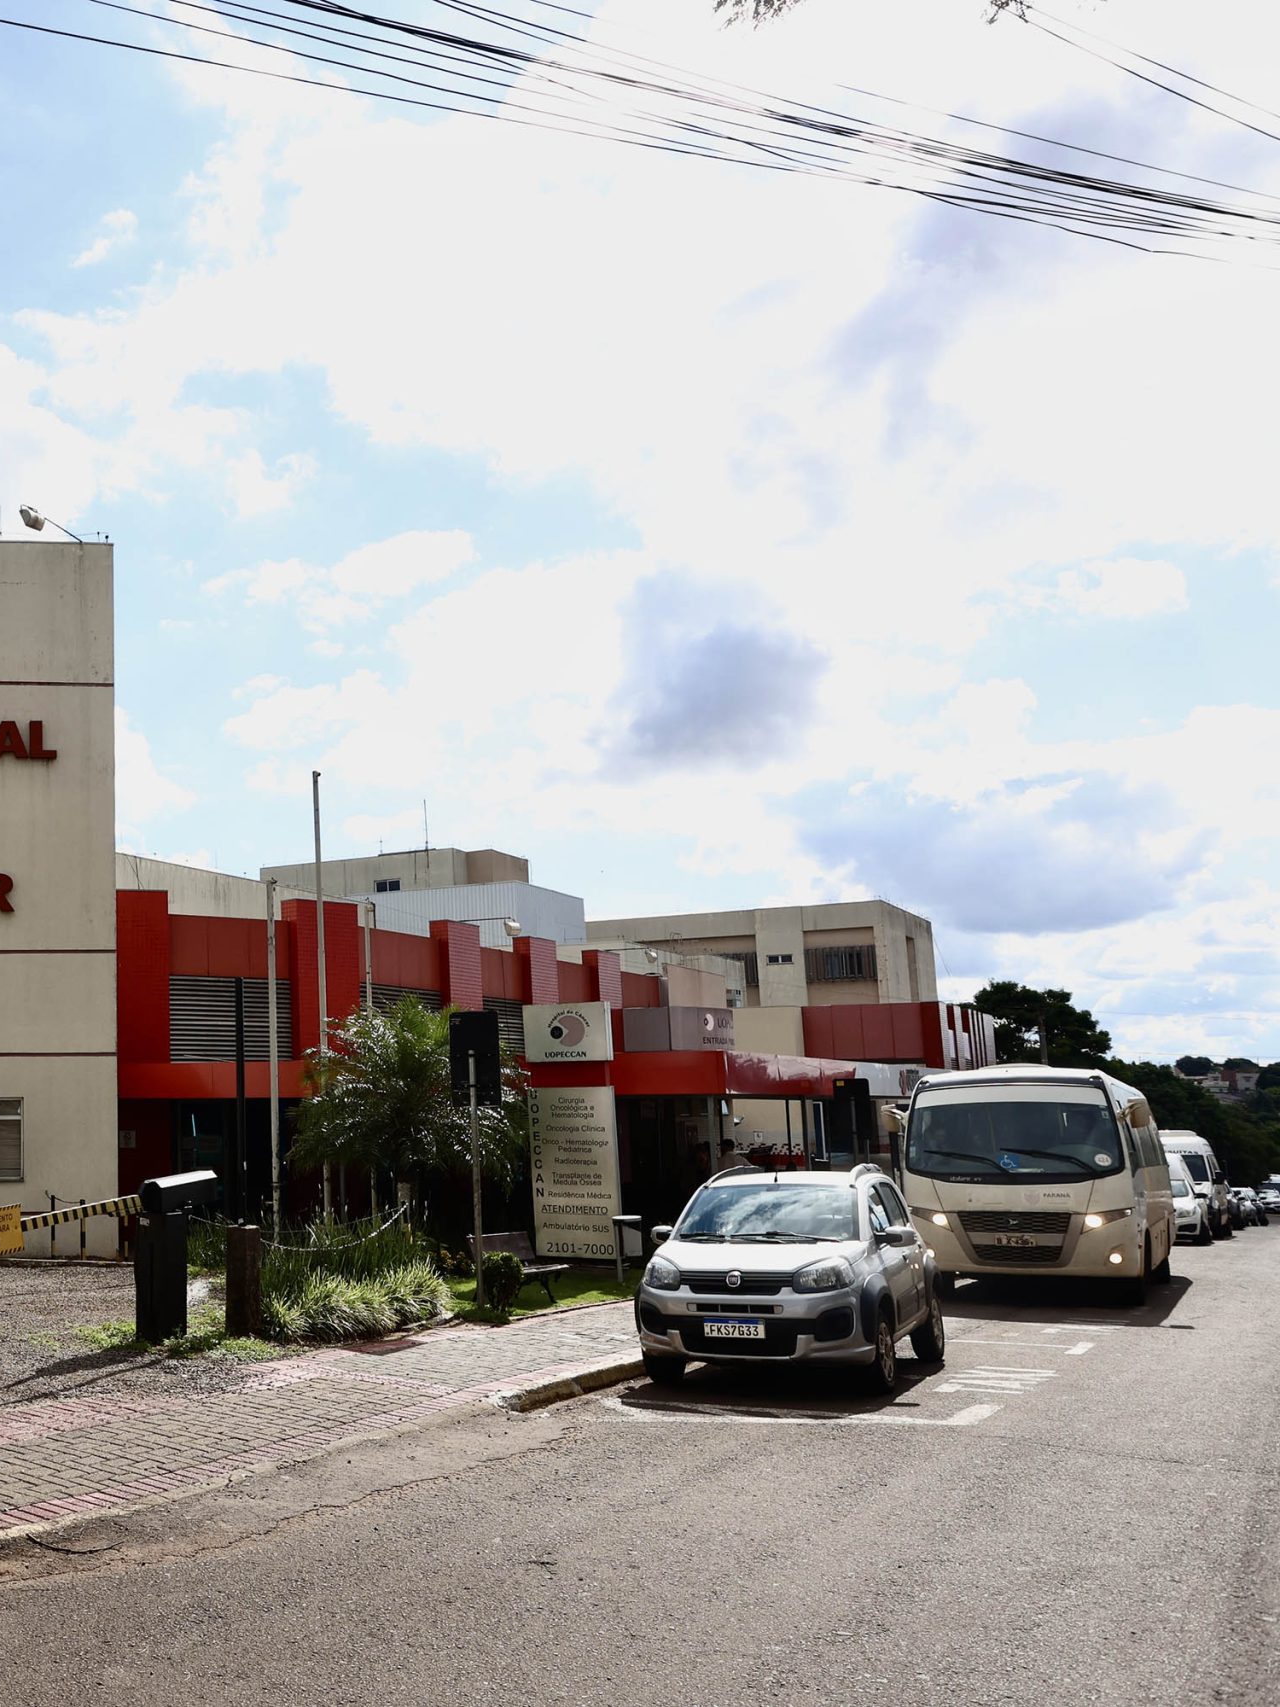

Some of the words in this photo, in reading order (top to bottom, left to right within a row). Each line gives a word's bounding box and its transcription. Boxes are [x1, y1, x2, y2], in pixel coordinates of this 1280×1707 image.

[530, 1089, 544, 1197] UOPECCAN
[554, 1157, 598, 1166] Radioterapia
[552, 1172, 591, 1180] Transplante
[541, 1204, 608, 1215] ATENDIMENTO
[542, 1222, 590, 1232] Ambulatório
[592, 1224, 610, 1233] SUS
[547, 1242, 614, 1255] 2101-7000
[709, 1325, 759, 1336] FKS7G33
